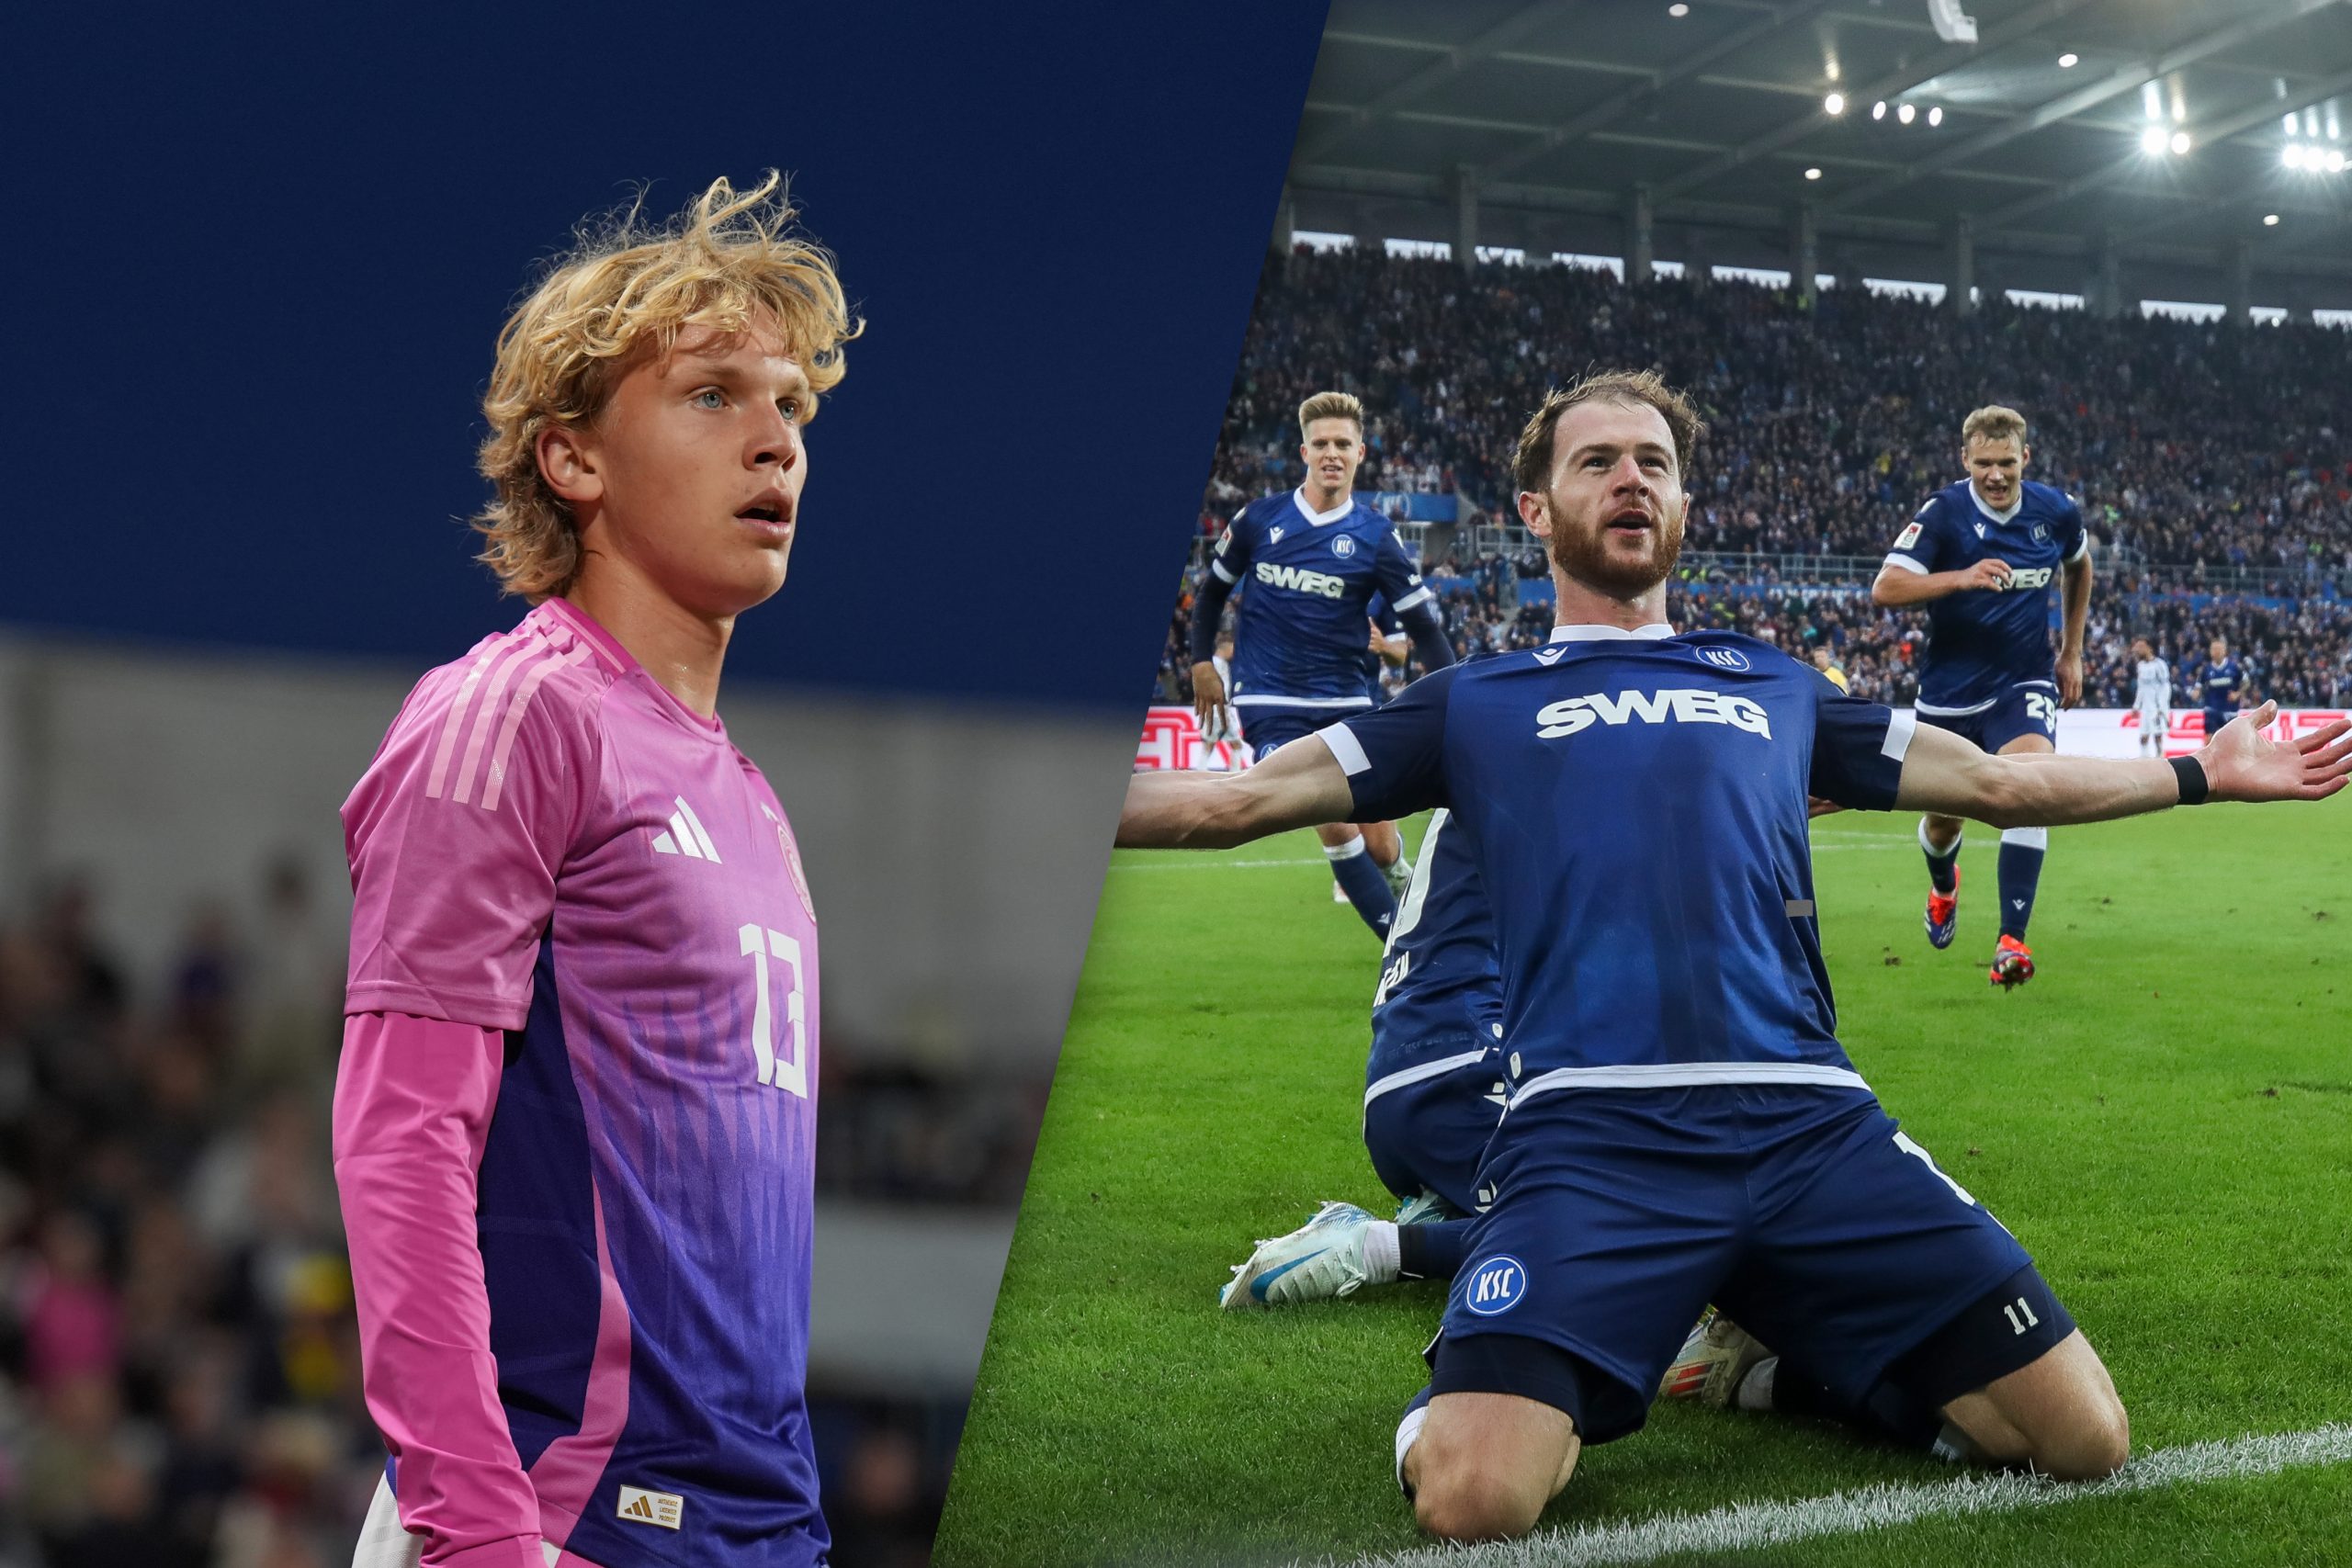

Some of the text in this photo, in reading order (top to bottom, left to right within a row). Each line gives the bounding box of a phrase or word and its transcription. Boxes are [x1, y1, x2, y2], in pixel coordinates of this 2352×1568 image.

[1336, 539, 1351, 554] KSC
[1256, 561, 1345, 599] SWEG
[1992, 567, 2052, 590] WEG
[1704, 650, 1742, 666] KSC
[1536, 688, 1772, 740] SWEG
[738, 922, 808, 1100] 13
[1476, 1267, 1515, 1303] KSC
[2004, 1296, 2040, 1336] 11
